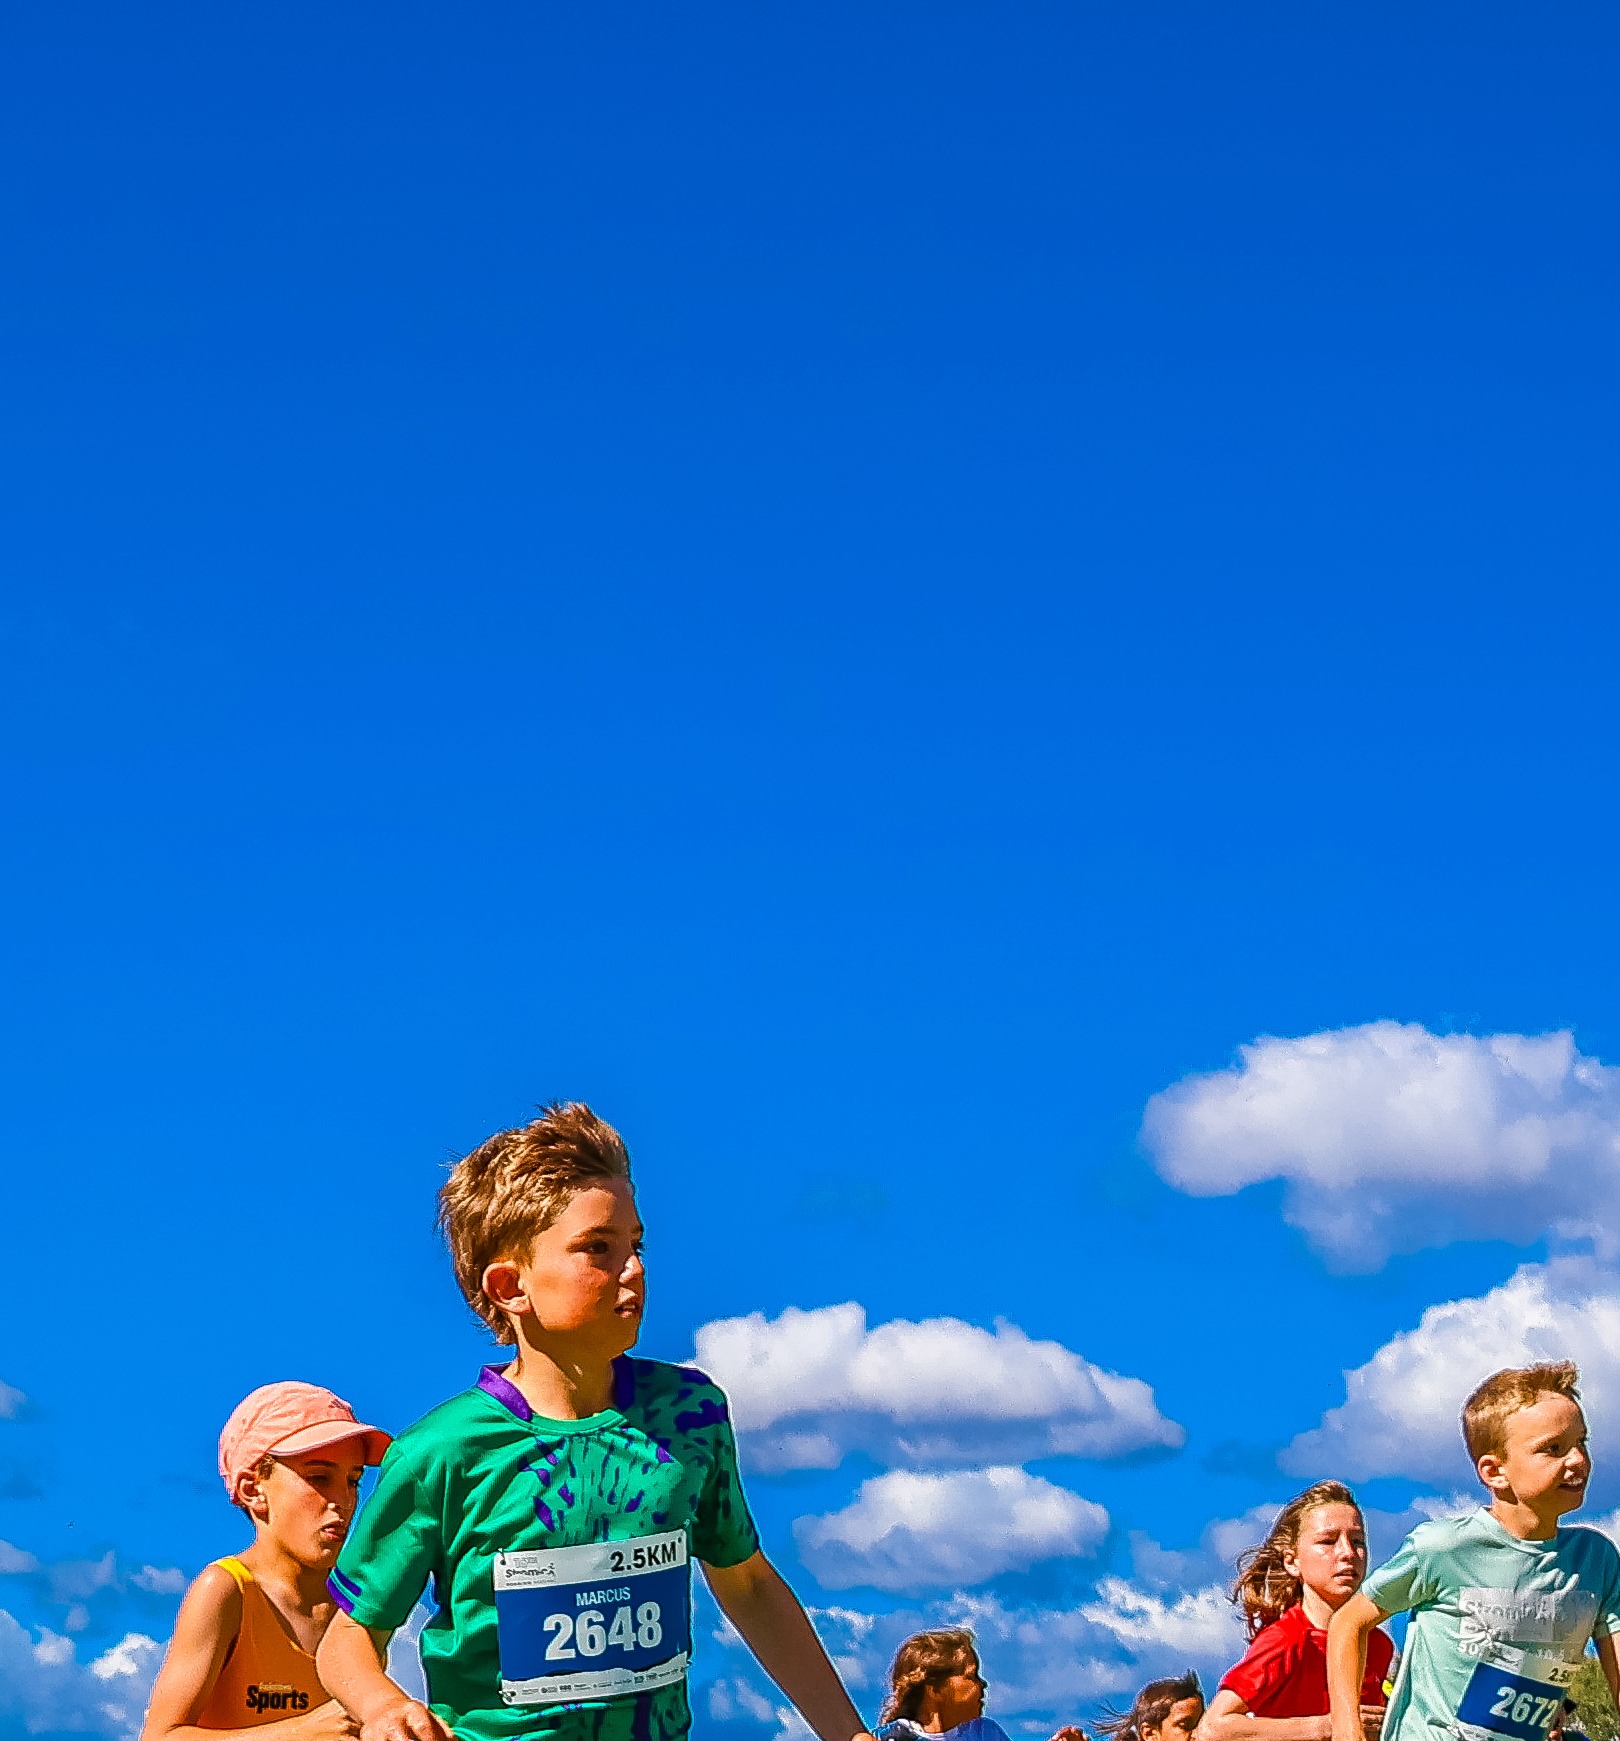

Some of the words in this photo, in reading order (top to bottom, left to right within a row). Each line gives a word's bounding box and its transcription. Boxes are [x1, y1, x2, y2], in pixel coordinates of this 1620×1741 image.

[610, 1540, 677, 1573] 2.5KM
[576, 1587, 631, 1606] MARCUS
[543, 1601, 663, 1660] 2648
[246, 1684, 309, 1714] Sports
